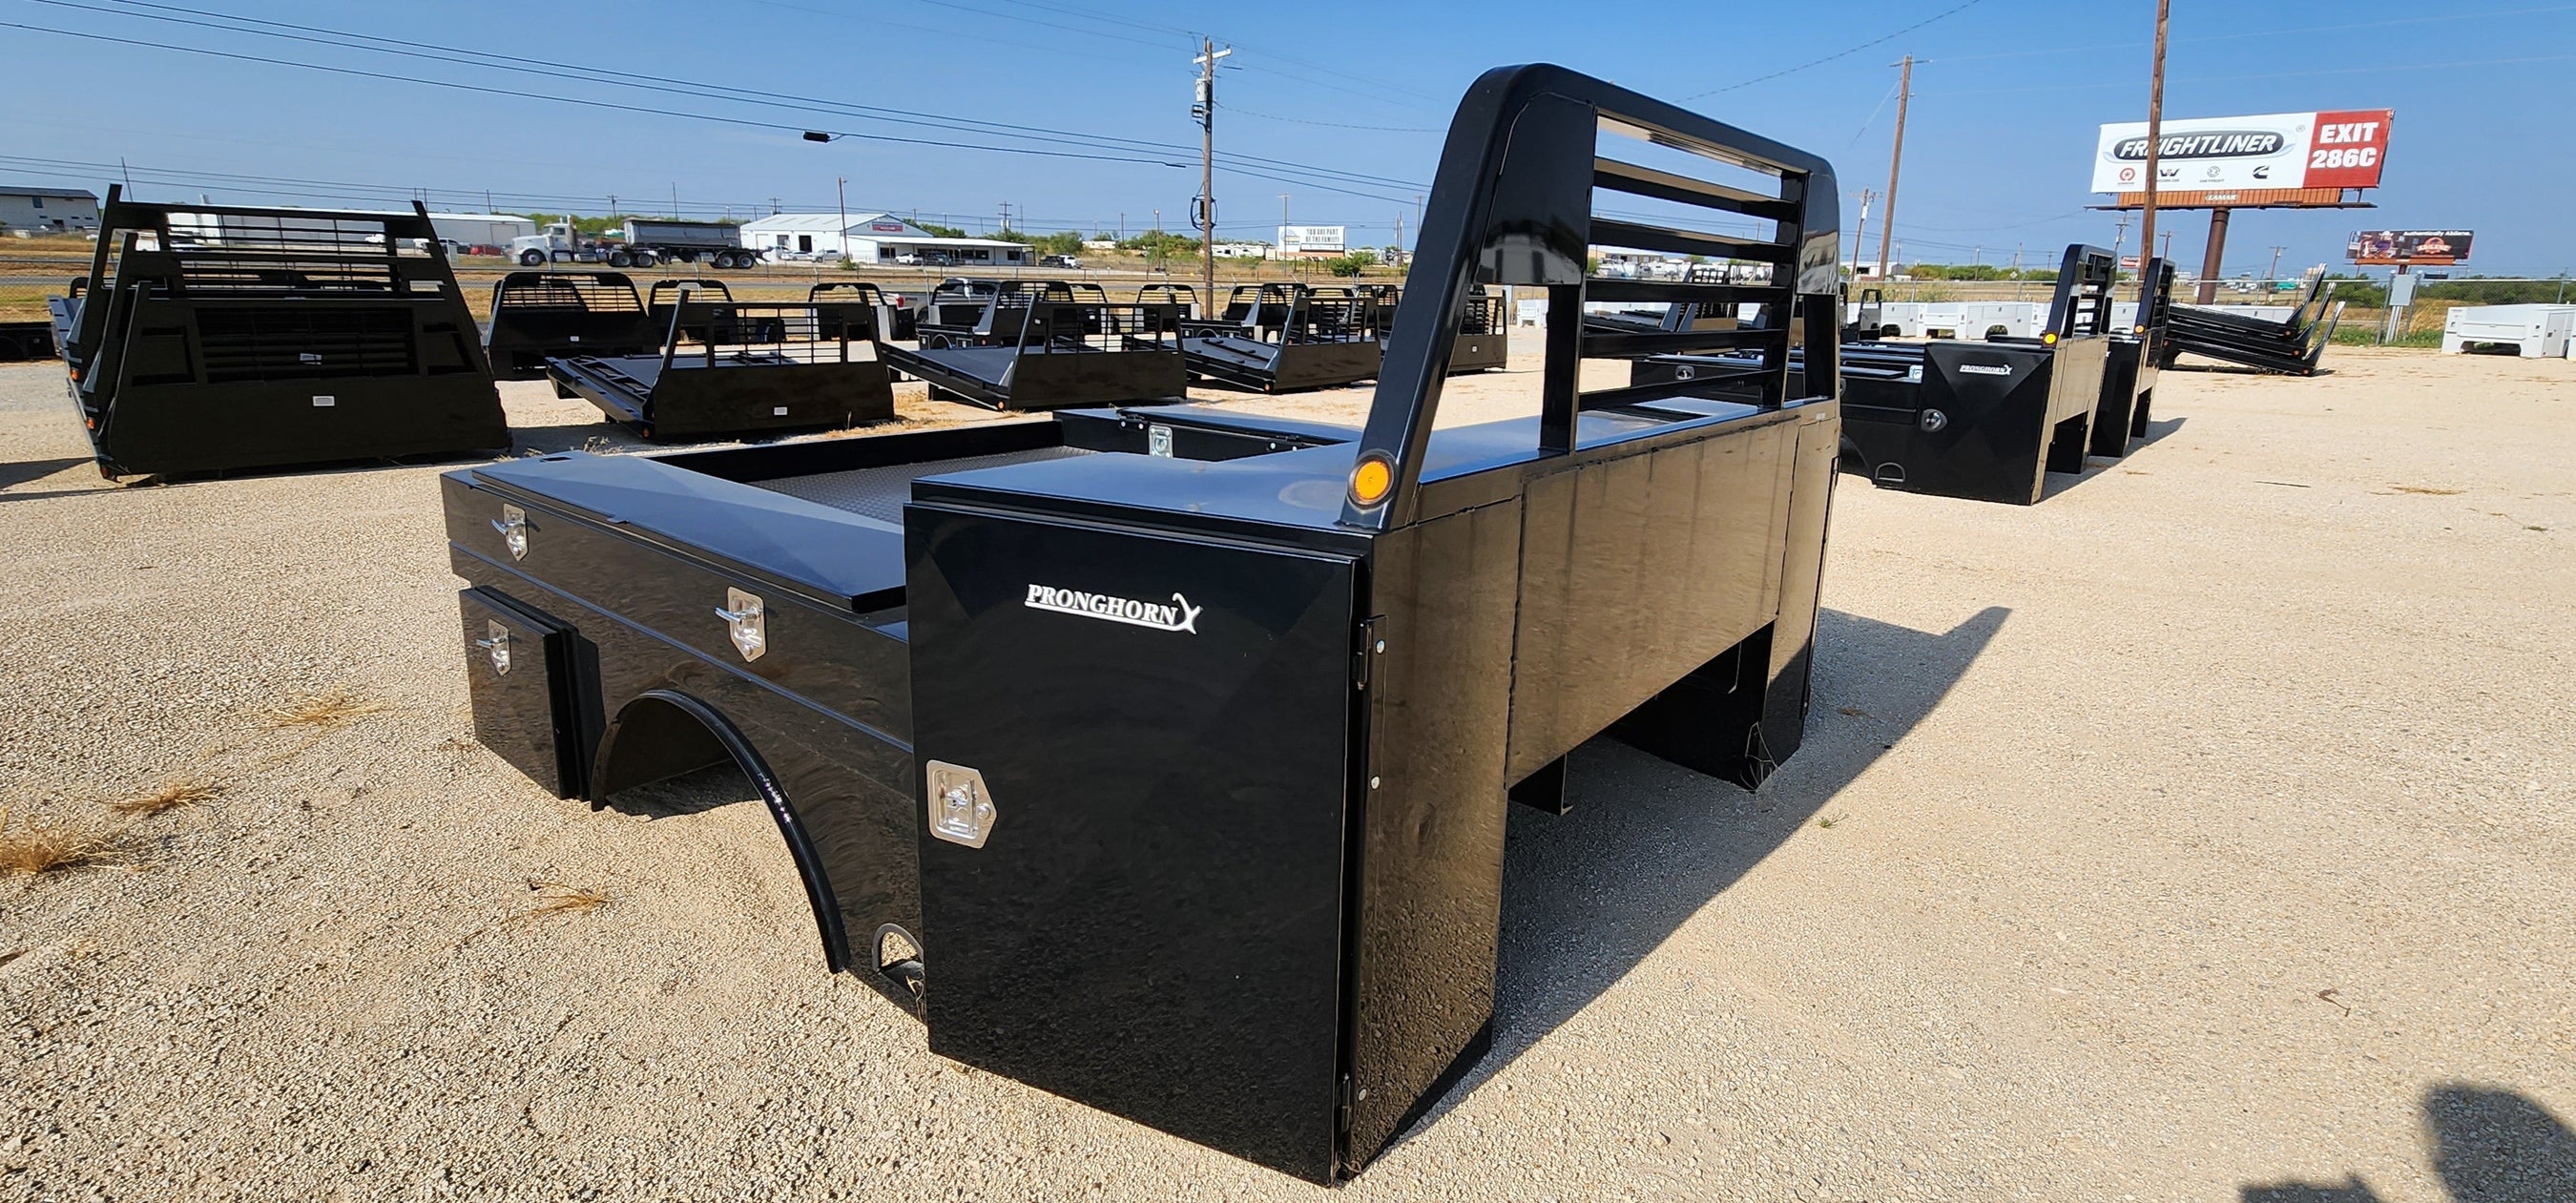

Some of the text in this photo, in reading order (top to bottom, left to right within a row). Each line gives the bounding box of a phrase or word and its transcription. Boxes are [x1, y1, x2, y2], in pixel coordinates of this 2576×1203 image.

[2318, 121, 2379, 144] EXIT
[2119, 135, 2277, 157] FRIGHTLINER
[2310, 146, 2378, 169] 286C
[1960, 364, 2006, 373] PRONGHORN
[1026, 584, 1179, 626] PRONGHORN
